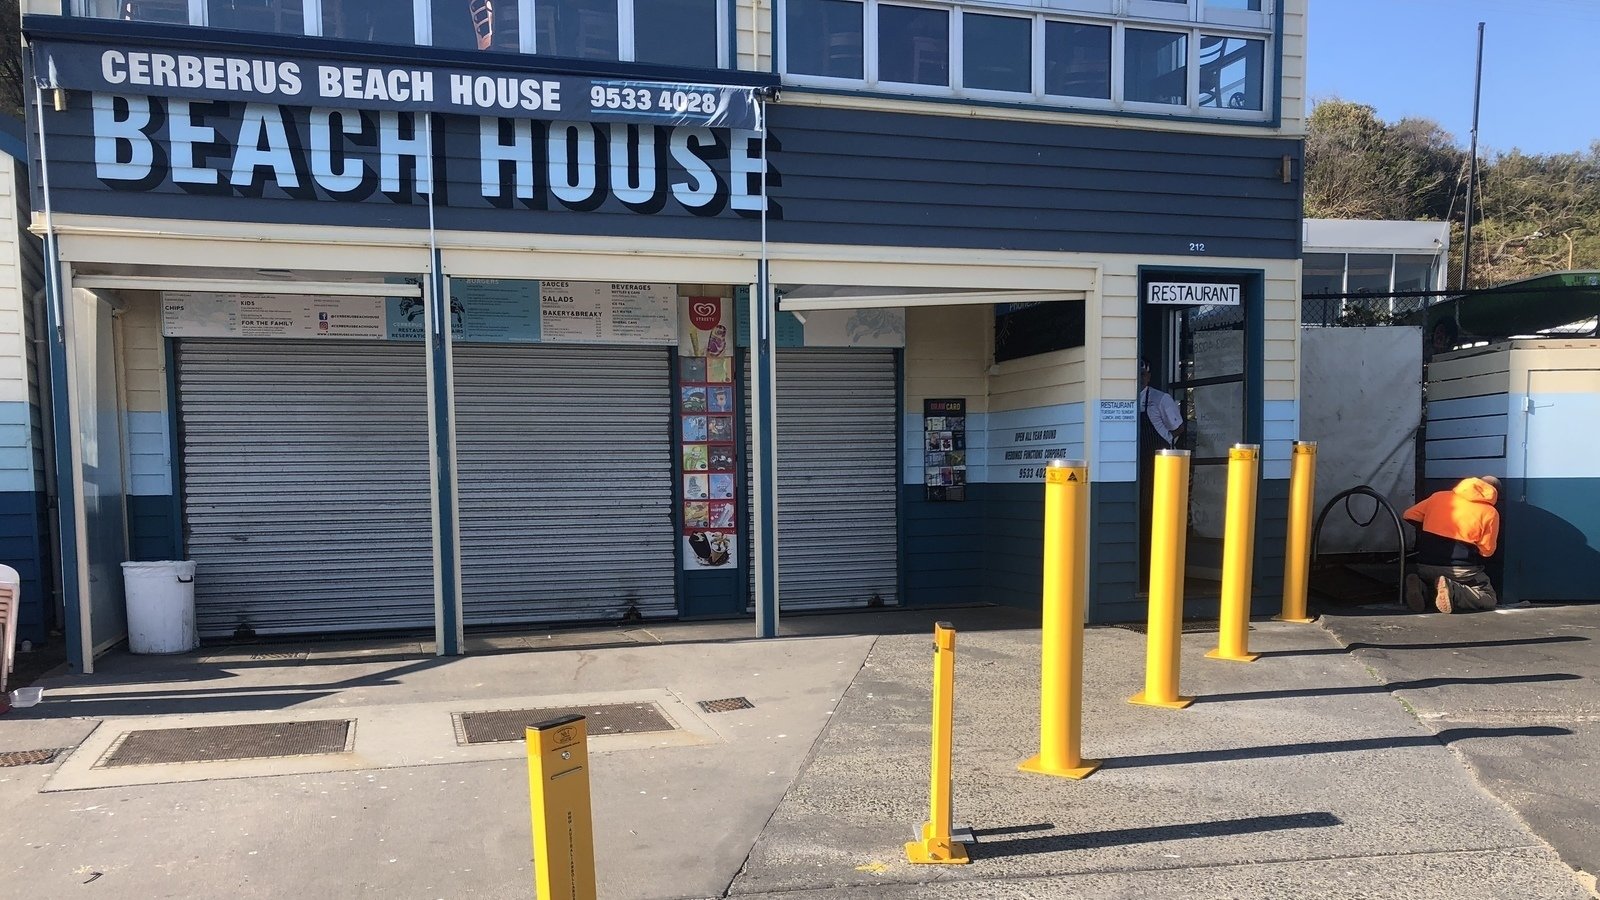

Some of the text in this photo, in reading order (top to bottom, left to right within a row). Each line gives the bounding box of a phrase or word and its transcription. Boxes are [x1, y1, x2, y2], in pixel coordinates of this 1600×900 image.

[101, 50, 716, 113] CERBERUS BEACH HOUSE 9533 4028
[91, 92, 768, 211] BEACH HOUSE
[1189, 242, 1206, 252] 212
[1151, 285, 1239, 302] RESTAURANT
[1100, 401, 1135, 409] RESTAURANT
[1015, 432, 1025, 442] OPEN
[1032, 430, 1043, 441] YEAR
[1043, 429, 1057, 440] ROUND
[1005, 448, 1067, 460] WEDDINGS FUNCTIONS CORPORATE
[1019, 468, 1034, 479] 9533
[1035, 467, 1046, 478] 402
